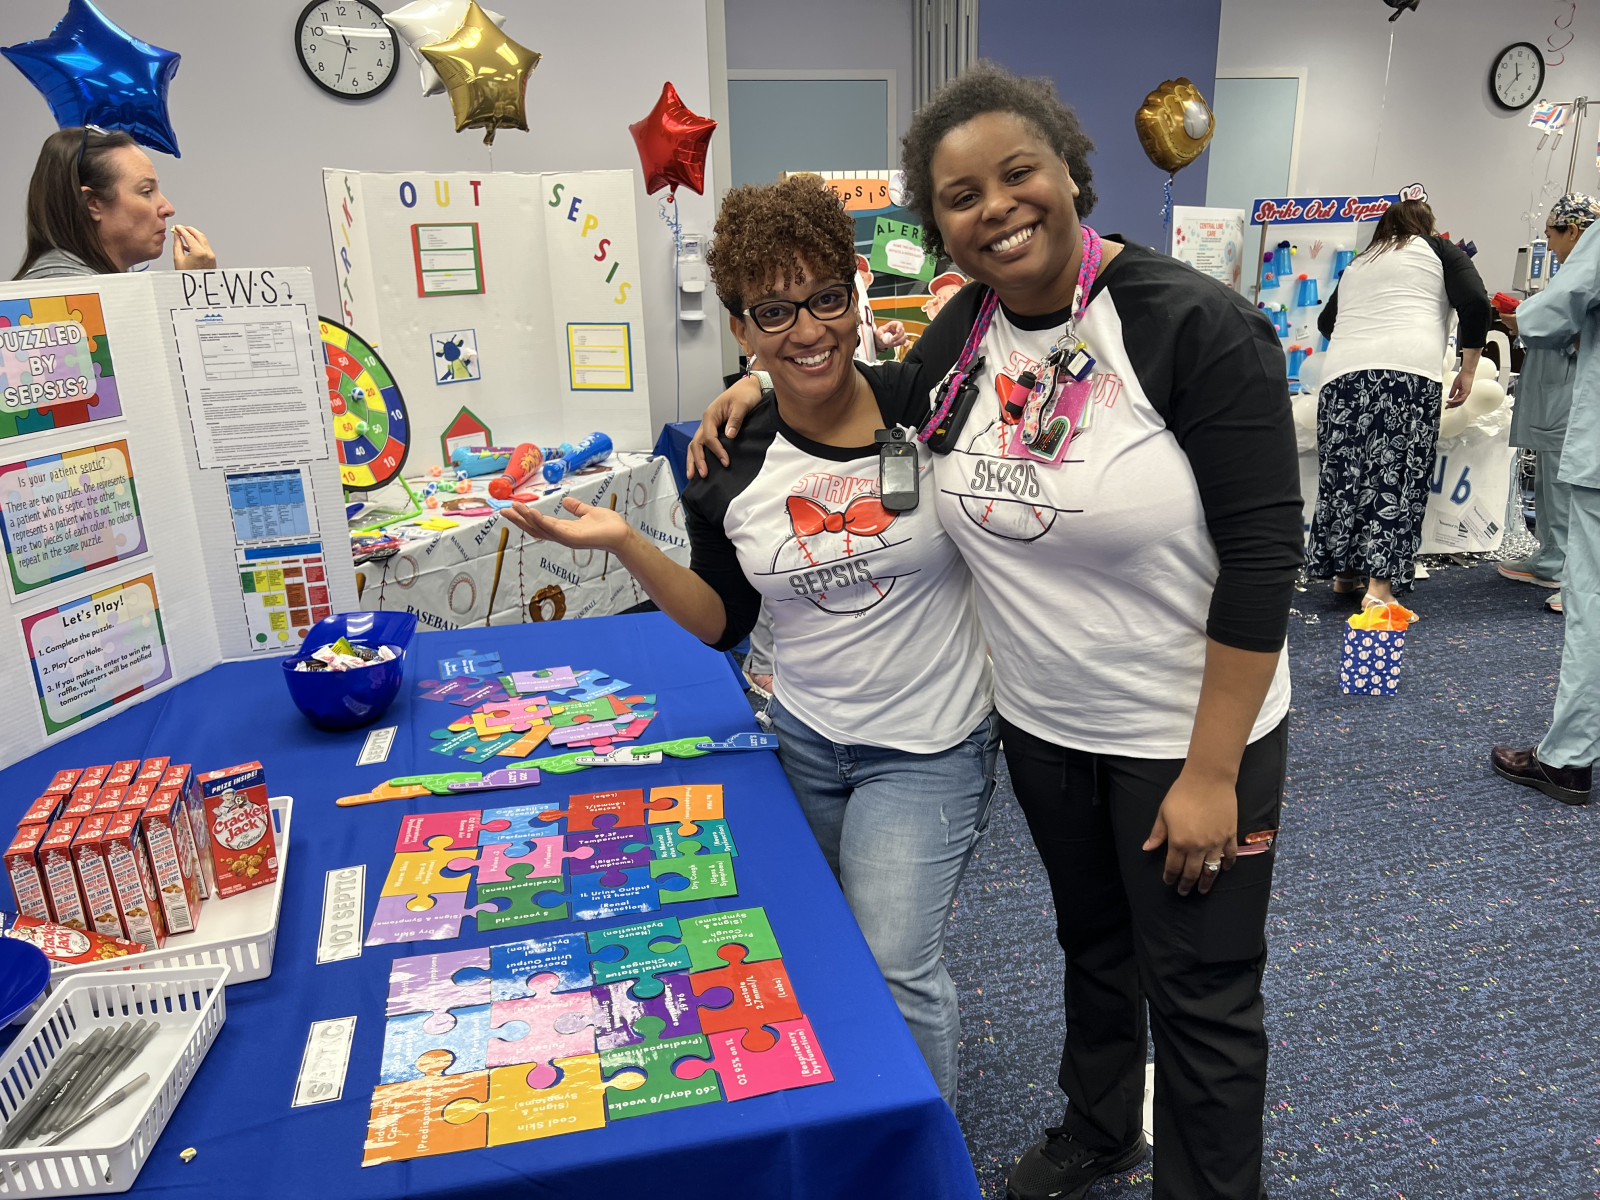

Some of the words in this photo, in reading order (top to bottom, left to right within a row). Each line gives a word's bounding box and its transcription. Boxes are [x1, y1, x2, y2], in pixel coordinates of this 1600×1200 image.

[321, 13, 329, 22] 11
[336, 7, 347, 16] 12
[311, 27, 324, 36] 10
[310, 44, 316, 53] 9
[380, 41, 386, 50] 3
[318, 62, 325, 71] 8
[377, 59, 383, 67] 4
[335, 74, 341, 83] 7
[352, 77, 359, 87] 6
[367, 72, 374, 81] 5
[399, 180, 481, 208] OUT
[1255, 199, 1302, 221] Strike
[1304, 199, 1337, 219] Out
[1341, 196, 1391, 221] Sepsis
[877, 221, 919, 239] ALER
[548, 183, 632, 304] SEPSIS
[29, 354, 56, 376] BY
[338, 357, 349, 367] 50
[364, 356, 376, 368] 10
[4, 376, 88, 408] SEPSIS?
[366, 387, 376, 397] 20
[391, 409, 403, 421] 10
[342, 423, 353, 432] 60
[372, 424, 383, 434] 50
[355, 446, 366, 457] 40
[383, 456, 396, 468] 10
[18, 476, 26, 488] Is
[29, 474, 47, 490] your
[50, 464, 78, 482] patient
[80, 456, 107, 475] septic?
[342, 471, 356, 483] 10
[971, 459, 1040, 498] SEPSIS
[6, 501, 27, 514] There
[29, 498, 40, 507] are
[42, 495, 54, 506] two
[56, 487, 83, 505] puzzles.
[83, 482, 96, 494] One
[96, 474, 126, 490] represents
[1450, 465, 1471, 506] 6
[16, 511, 43, 528] patient
[43, 506, 57, 518] who
[58, 503, 64, 514] is
[87, 493, 98, 506] the
[99, 490, 116, 504] other
[12, 524, 48, 542] represents
[55, 514, 78, 531] patient
[80, 510, 93, 521] who
[94, 507, 99, 517] is
[114, 500, 131, 512] There
[16, 543, 28, 555] are
[29, 538, 43, 551] two
[43, 532, 64, 548] pieces
[64, 528, 73, 540] of
[74, 524, 89, 537] each
[108, 517, 116, 527] no
[117, 511, 134, 524] colors
[640, 521, 687, 549] BASEBALL
[19, 554, 41, 569] repeat
[42, 551, 49, 561] in
[50, 546, 62, 559] the
[63, 541, 79, 554] same
[80, 534, 104, 549] puzzle.
[539, 557, 581, 588] BASEBALL
[789, 558, 873, 597] SEPSIS
[94, 595, 124, 616] Play!
[45, 636, 79, 655] Complete
[79, 631, 91, 641] the
[91, 623, 115, 638] puzzle.
[42, 667, 51, 676] 2.
[51, 659, 68, 673] Play
[68, 653, 86, 664] Corn
[86, 646, 104, 658] Hole.
[46, 685, 55, 693] 3.
[55, 680, 61, 689] If
[62, 677, 75, 689] you
[76, 668, 95, 681] make
[95, 665, 103, 673] it,
[103, 658, 121, 670] enter
[128, 648, 141, 658] win
[141, 643, 151, 653] the
[58, 685, 79, 698] raffle.
[79, 671, 108, 689] Winners
[108, 664, 120, 676] will
[121, 662, 129, 670] be
[129, 652, 152, 667] notified
[59, 686, 97, 707] tomorrow!
[365, 730, 391, 761] SEPTIC
[212, 780, 232, 794] PRIZE
[233, 769, 258, 785] INSIDE!
[212, 803, 268, 835] Cracker
[225, 819, 260, 843] Jack
[579, 834, 634, 845] Temperature
[691, 864, 700, 879] Cough
[719, 861, 728, 887] Symptoms)
[332, 869, 358, 922] SEPTIC
[591, 889, 615, 897] Urine
[619, 884, 651, 893] Output
[695, 912, 747, 926] Symptoms)
[41, 921, 56, 956] Cracker
[603, 921, 664, 938] Dysfunction)
[702, 932, 754, 944] Productive
[710, 928, 741, 938] Cough
[56, 931, 74, 954] Jack
[506, 959, 542, 969] Output
[511, 960, 568, 974] Decreased
[545, 954, 572, 962] Urine
[620, 957, 665, 970] Changes
[605, 968, 642, 979] Status
[740, 981, 752, 1008] Lactate
[747, 975, 764, 1010] 2.7mmol/L
[774, 977, 788, 999] (Labs)
[608, 1038, 703, 1060] (Predispositions)
[730, 1045, 739, 1055] on
[787, 1031, 809, 1078] (Respiratory
[798, 1028, 822, 1075] Dysfunction)
[731, 1055, 745, 1073] 95%
[650, 1089, 692, 1104] days/8
[695, 1085, 717, 1096] <60
[608, 1098, 647, 1111] weeks
[517, 1120, 544, 1131] Skin
[547, 1115, 577, 1128] Cool
